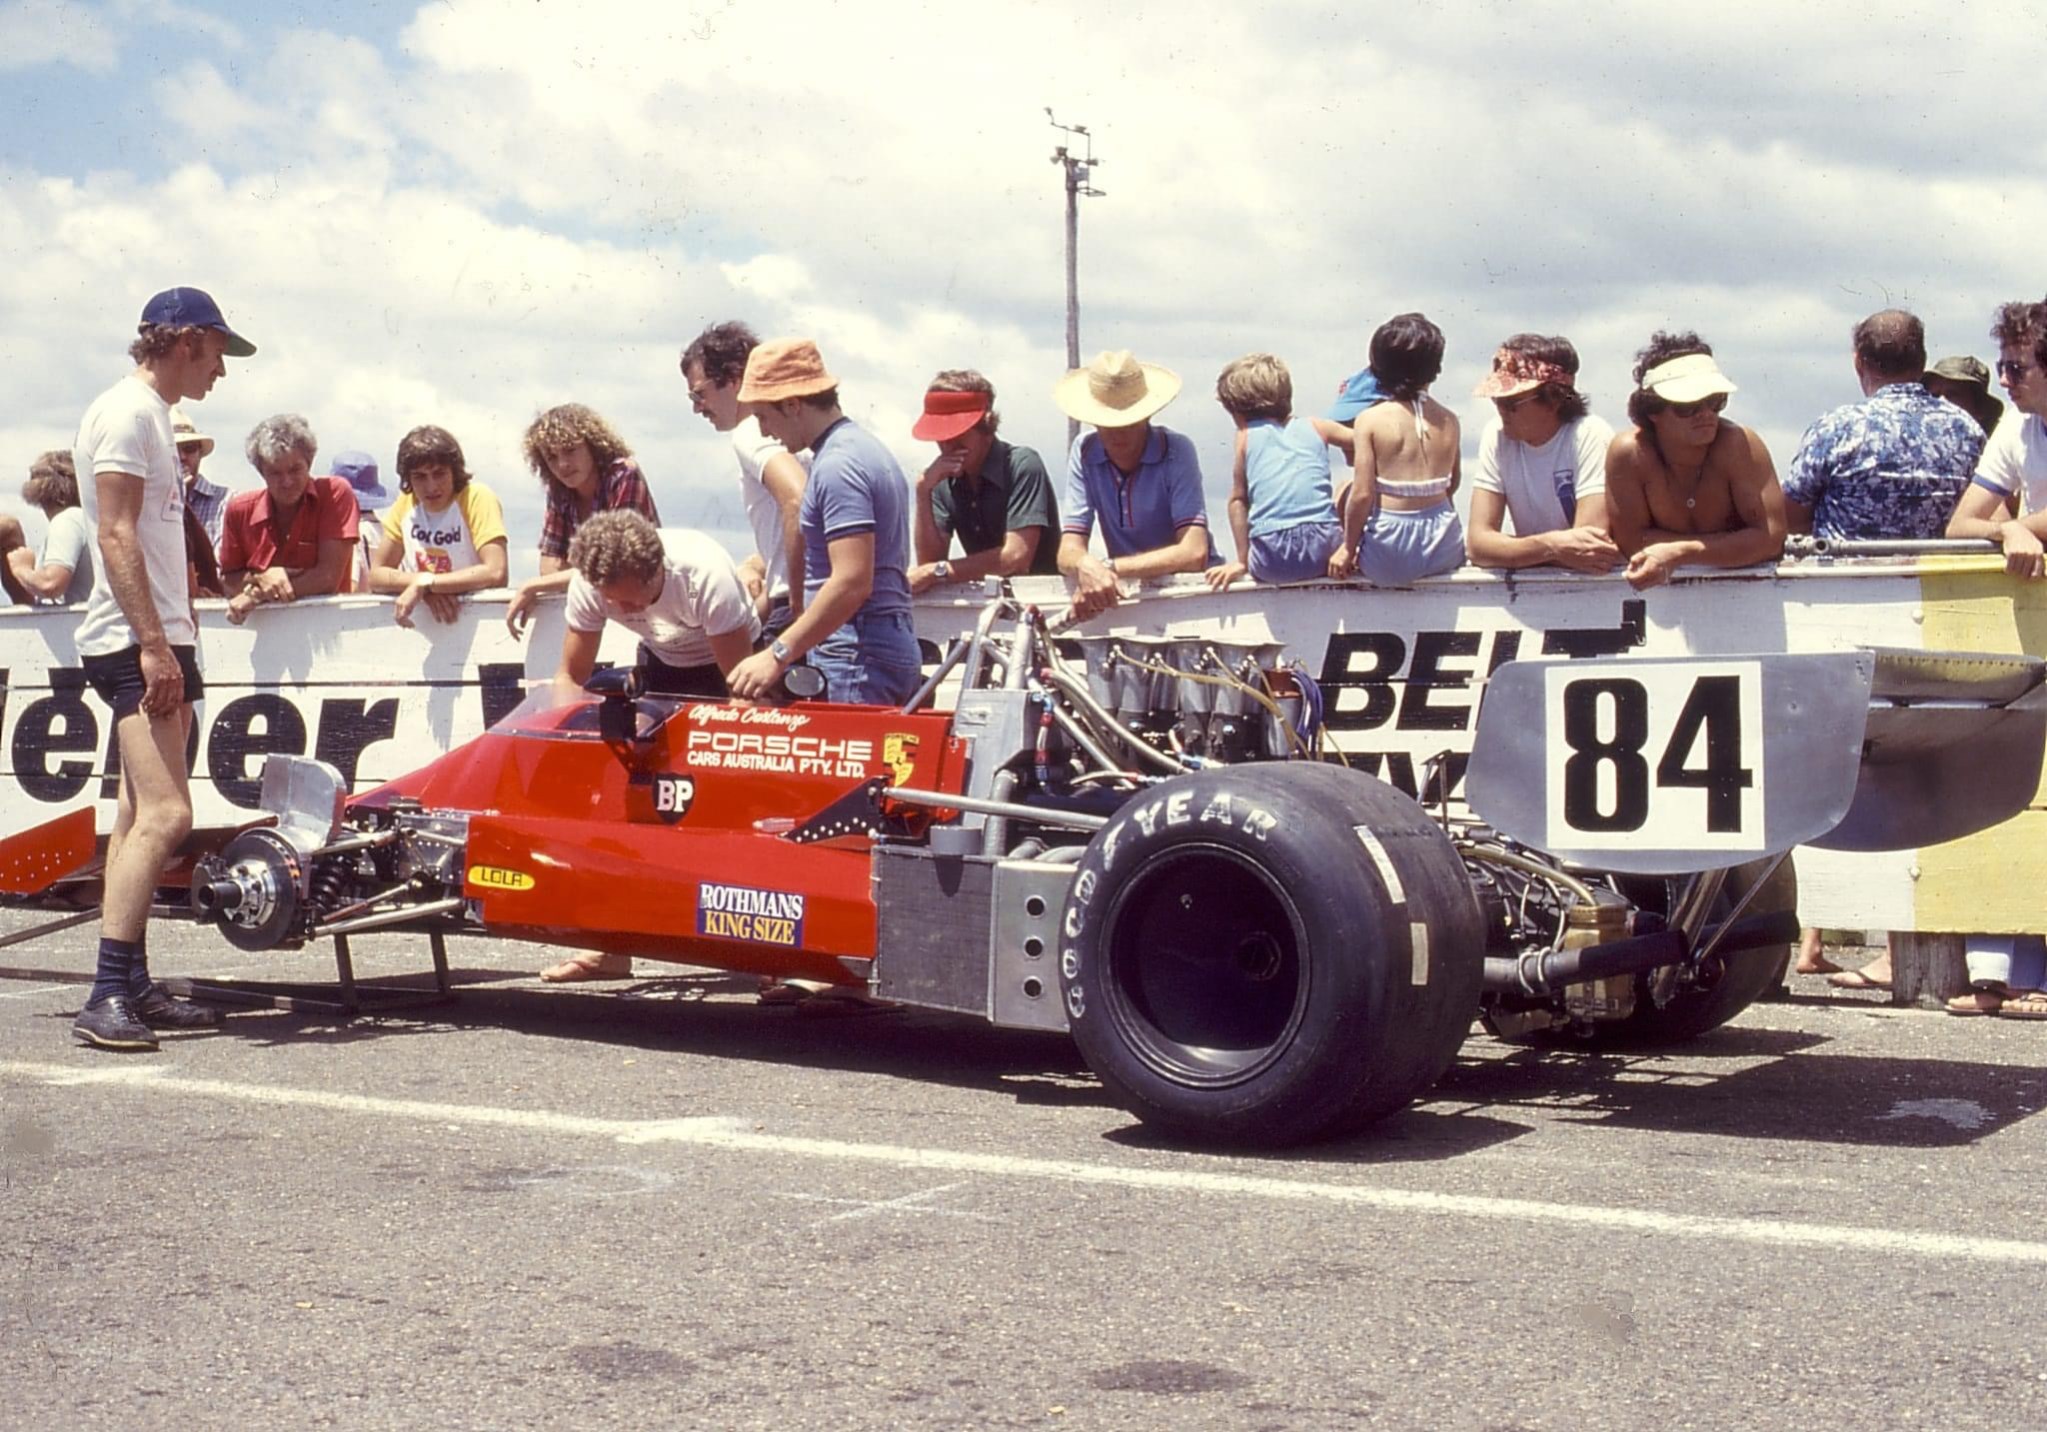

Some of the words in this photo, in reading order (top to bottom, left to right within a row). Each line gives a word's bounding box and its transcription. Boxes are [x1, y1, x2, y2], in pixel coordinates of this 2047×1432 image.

[0, 667, 400, 811] éer
[688, 730, 873, 761] PORSCHE
[1563, 676, 1753, 834] 84
[687, 751, 721, 767] CARS
[723, 753, 795, 773] AUSTRALIA
[800, 758, 832, 775] PTY.
[836, 761, 866, 778] LTD.
[657, 780, 693, 812] BP
[481, 867, 523, 887] LOLA
[700, 883, 804, 920] ROTHMANS
[704, 910, 752, 939] KING
[753, 916, 796, 945] SIZE
